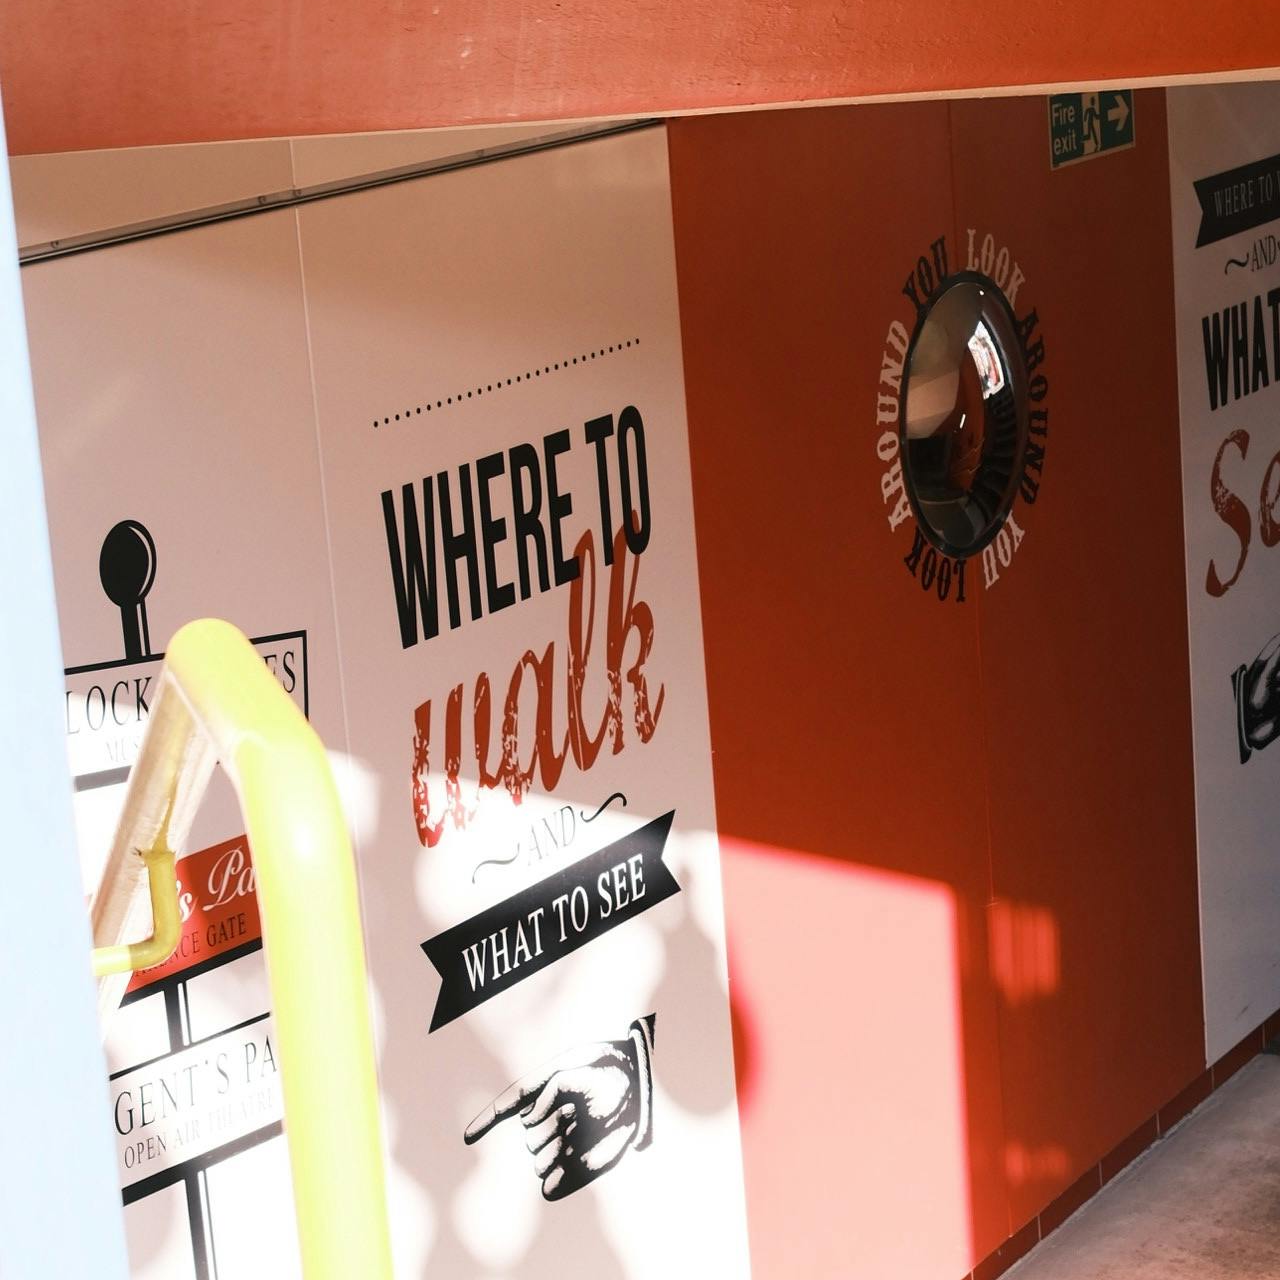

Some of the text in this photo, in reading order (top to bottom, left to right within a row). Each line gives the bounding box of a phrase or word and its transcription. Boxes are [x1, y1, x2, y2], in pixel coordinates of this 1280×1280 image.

[1051, 103, 1076, 127] Fire
[1053, 129, 1078, 155] exit
[1213, 179, 1255, 217] WHERE
[1258, 173, 1274, 204] TO
[966, 228, 1026, 311] LOOK
[1250, 234, 1278, 272] AND
[876, 235, 967, 603] LOOK AROUND YOU
[381, 404, 652, 651] WHERE TO
[982, 510, 1026, 591] YOU
[411, 509, 665, 848] walk
[526, 803, 577, 868] AND
[206, 912, 248, 948] GATE
[461, 853, 647, 994] WHAT TO SEE
[124, 1133, 168, 1169] OPEN
[173, 1119, 201, 1149] AIR
